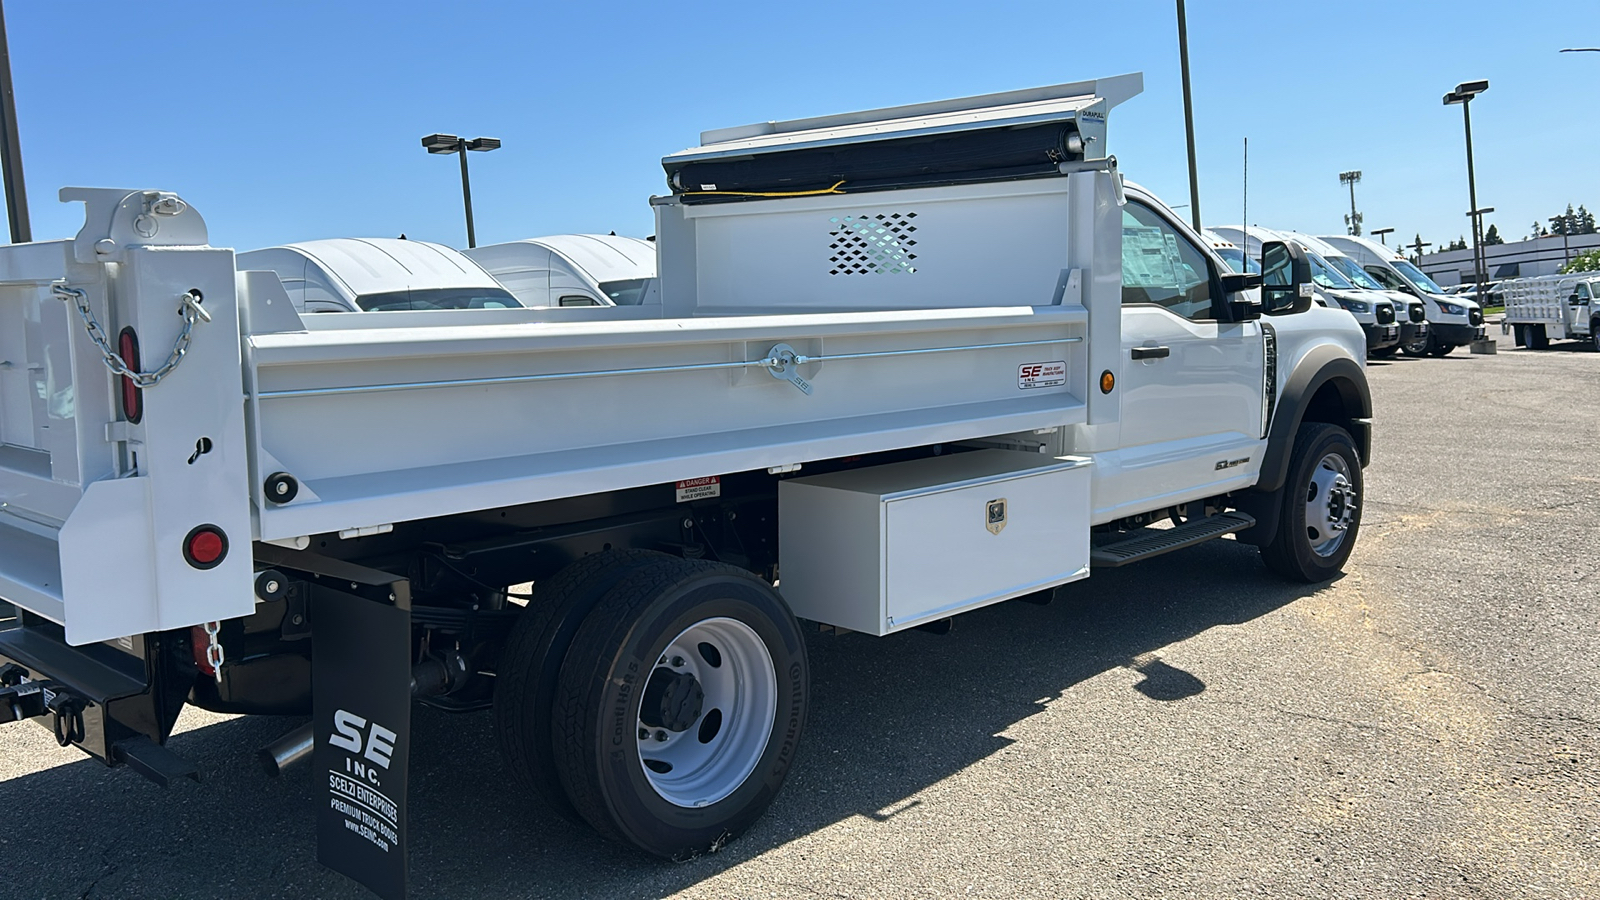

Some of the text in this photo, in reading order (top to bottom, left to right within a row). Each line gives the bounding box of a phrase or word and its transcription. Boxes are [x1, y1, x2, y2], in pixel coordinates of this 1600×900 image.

[1082, 110, 1105, 119] DURAPULL
[794, 376, 809, 390] SE
[1020, 365, 1043, 378] SE
[686, 477, 710, 487] DANGER
[693, 490, 717, 498] OPERATING
[618, 673, 635, 704] HSR
[612, 707, 625, 746] Conti
[780, 661, 803, 762] Continental
[329, 709, 397, 770] SE
[346, 757, 381, 787] INC.
[329, 774, 398, 823] SCELZI ENTERPRISES
[330, 798, 398, 846] PREMIUM TRUCK BODIES
[344, 819, 389, 853] www.SEINC.com
